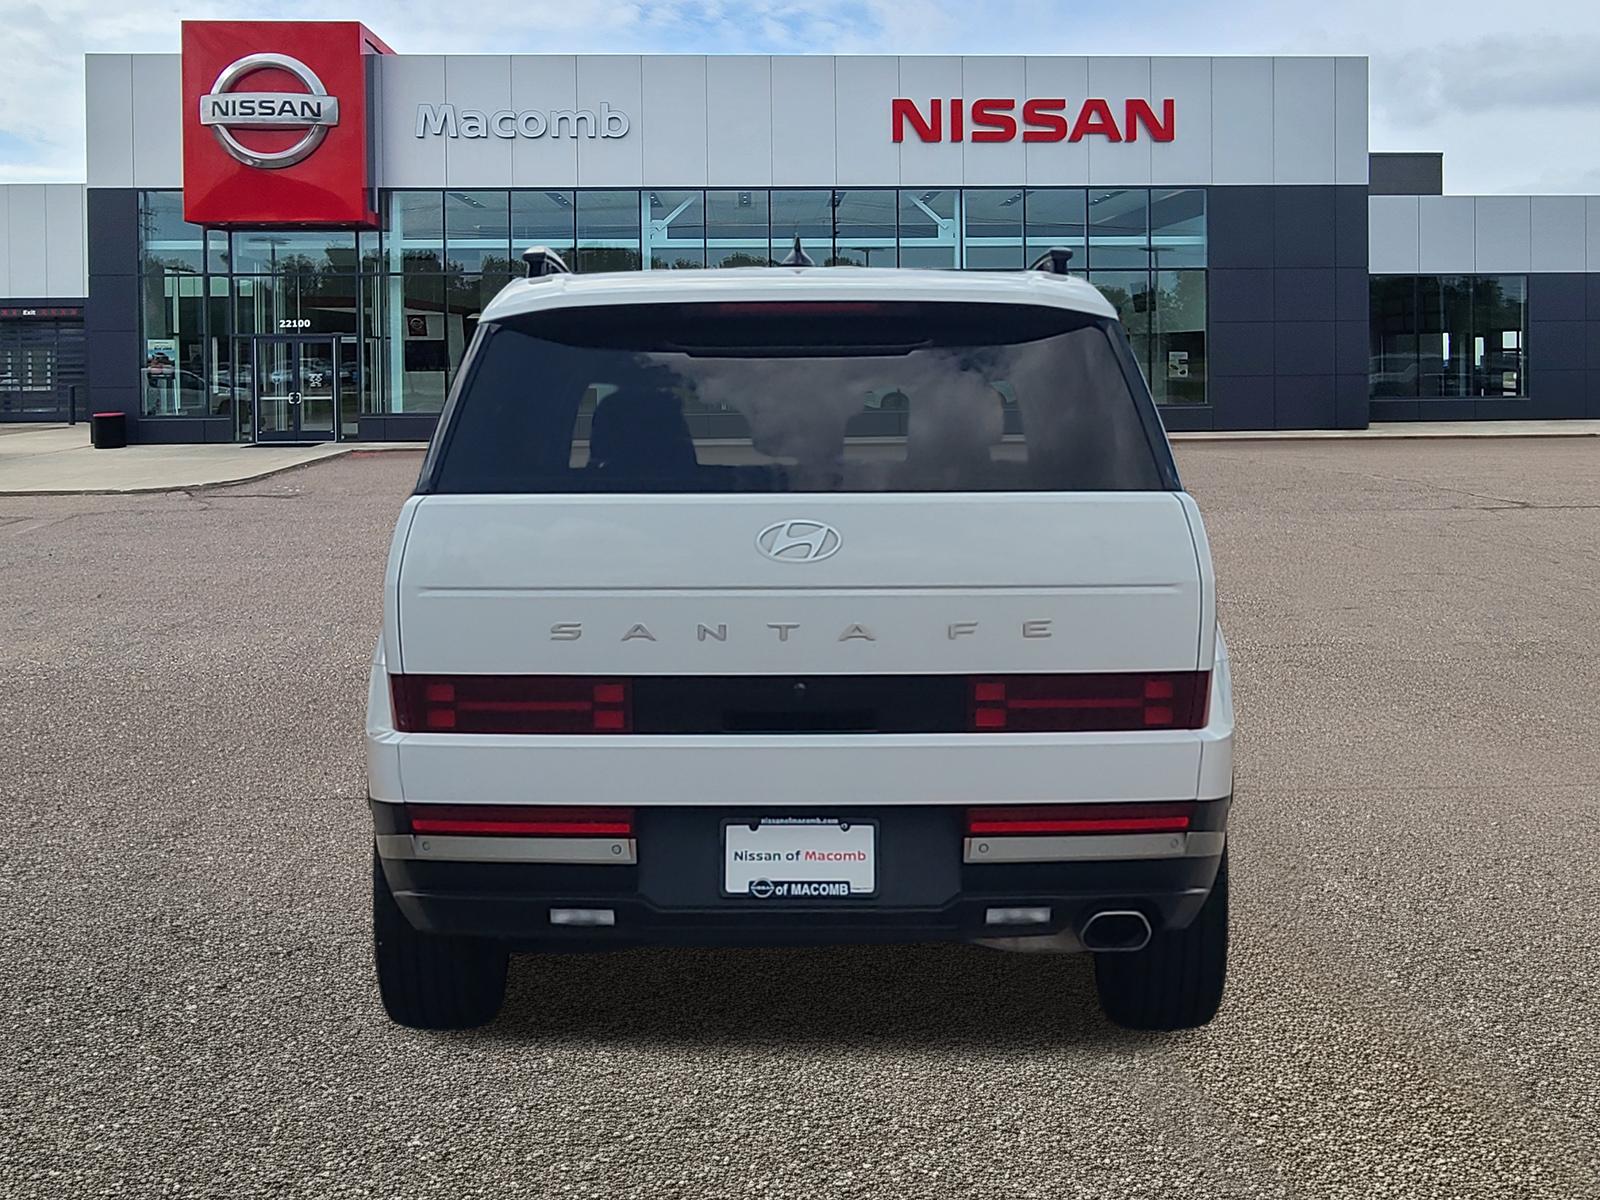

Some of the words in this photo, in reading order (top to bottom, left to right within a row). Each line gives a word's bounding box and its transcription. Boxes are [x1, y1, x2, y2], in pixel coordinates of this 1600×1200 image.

[211, 100, 322, 117] NISSAN
[415, 102, 630, 138] Macomb
[892, 98, 1175, 142] NISSAN
[279, 319, 311, 328] 22100
[550, 622, 876, 642] SANTA
[948, 620, 1053, 640] FE
[733, 850, 782, 862] Nissan
[785, 850, 801, 862] of
[804, 850, 867, 862] Macomb
[775, 883, 789, 896] of
[790, 883, 849, 896] MACOMB
